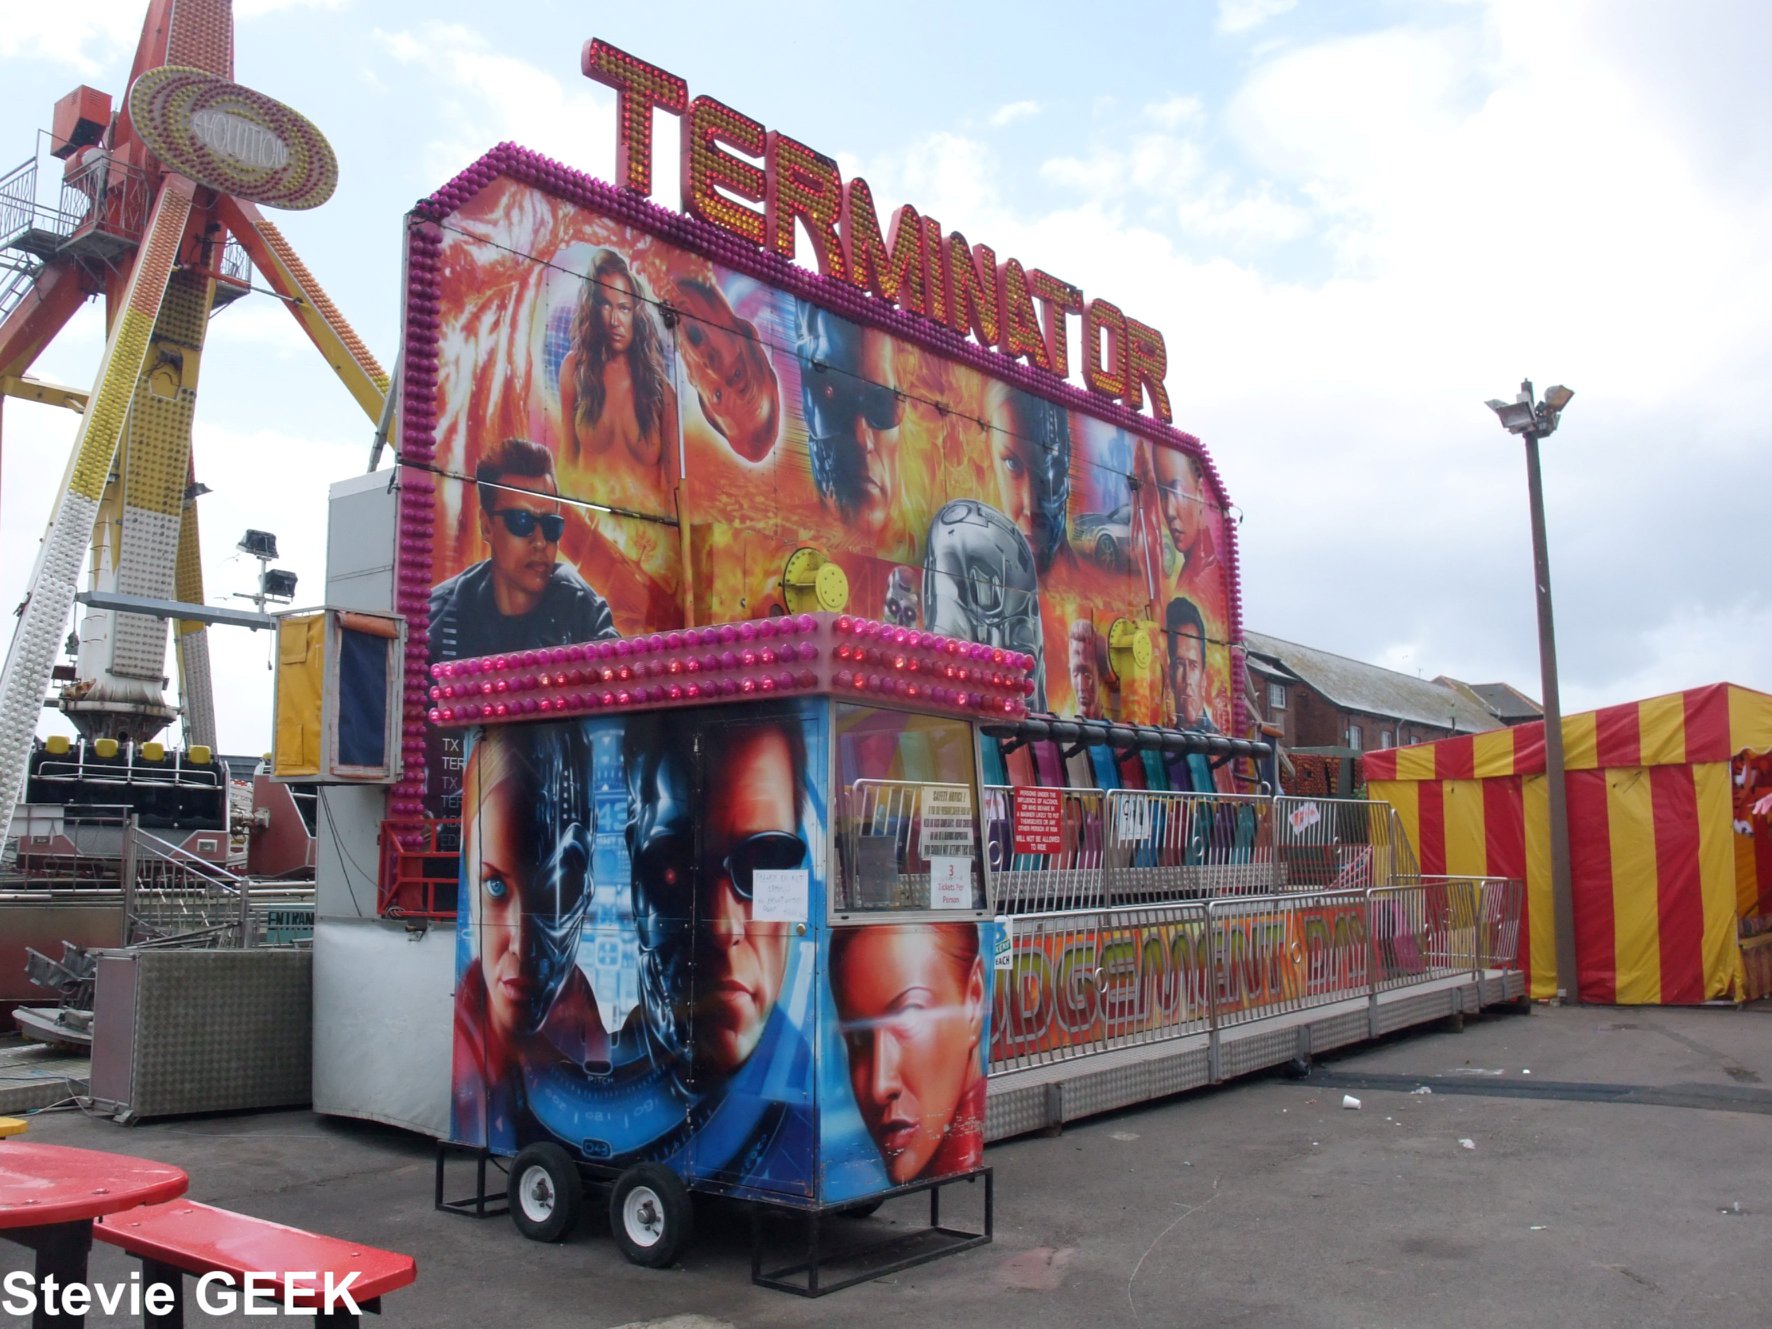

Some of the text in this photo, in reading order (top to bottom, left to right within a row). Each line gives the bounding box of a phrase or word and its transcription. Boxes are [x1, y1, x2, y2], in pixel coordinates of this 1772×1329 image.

[193, 112, 287, 168] EVOLUTION
[581, 37, 1172, 423] TERMINATOR
[442, 738, 459, 751] TX
[949, 864, 954, 876] 3
[267, 911, 315, 930] ENTRAN
[995, 955, 1010, 966] EACH
[587, 1076, 614, 1085] PITCH
